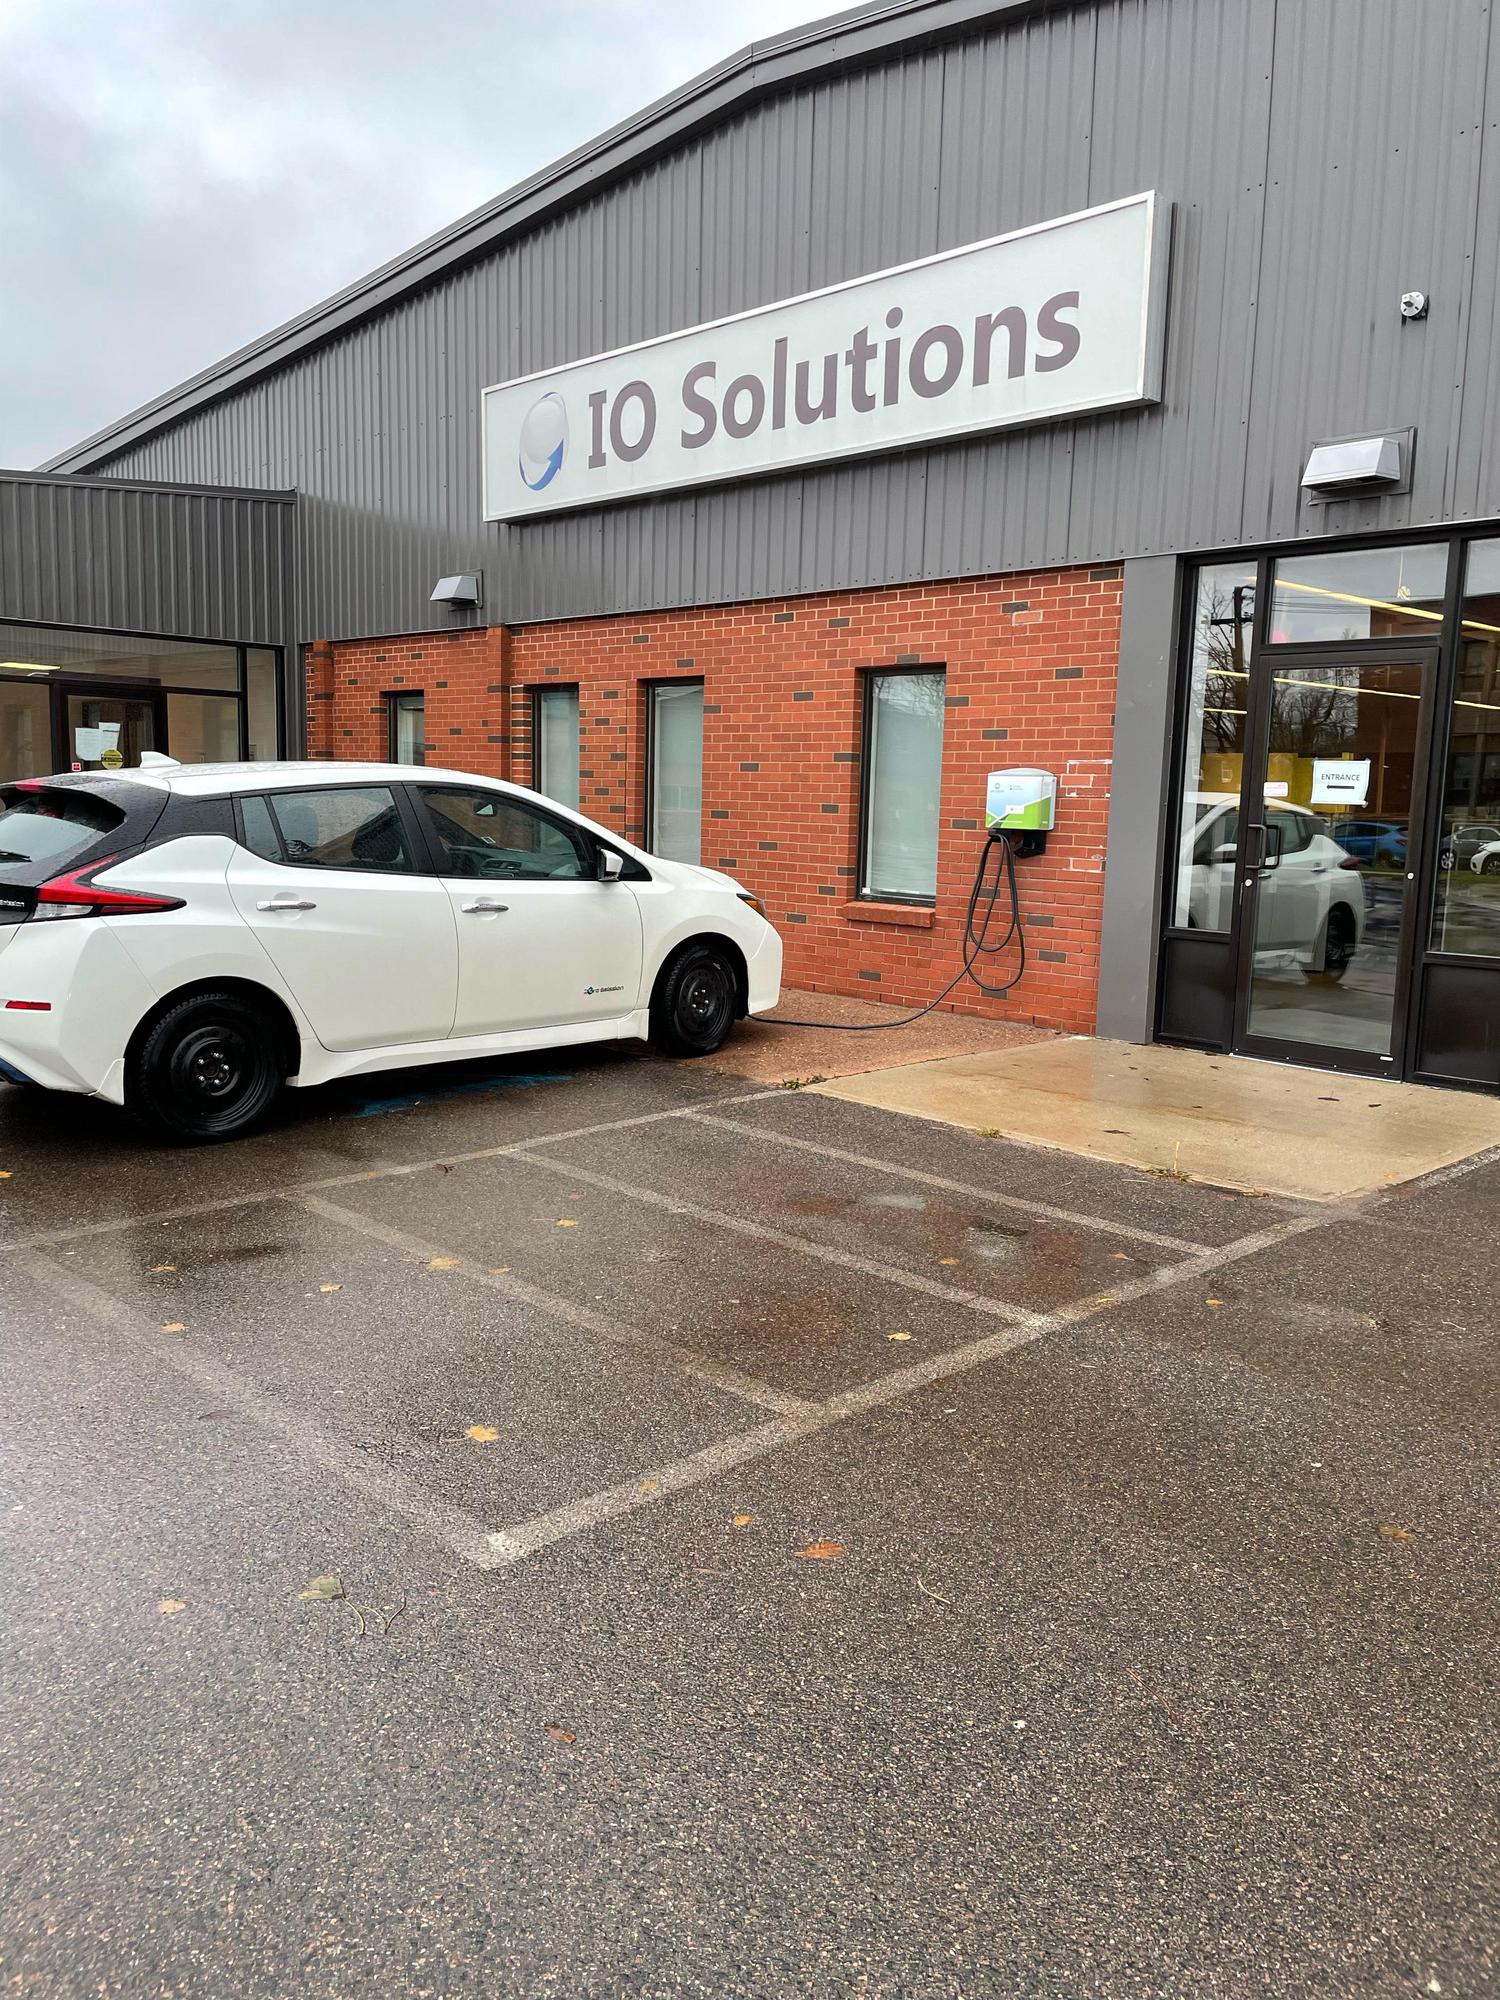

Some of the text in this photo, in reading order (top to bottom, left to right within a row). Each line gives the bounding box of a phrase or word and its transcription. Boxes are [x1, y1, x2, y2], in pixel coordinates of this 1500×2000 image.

[587, 290, 1081, 469] IO Solutions
[1321, 773, 1361, 781] ENTRANCE
